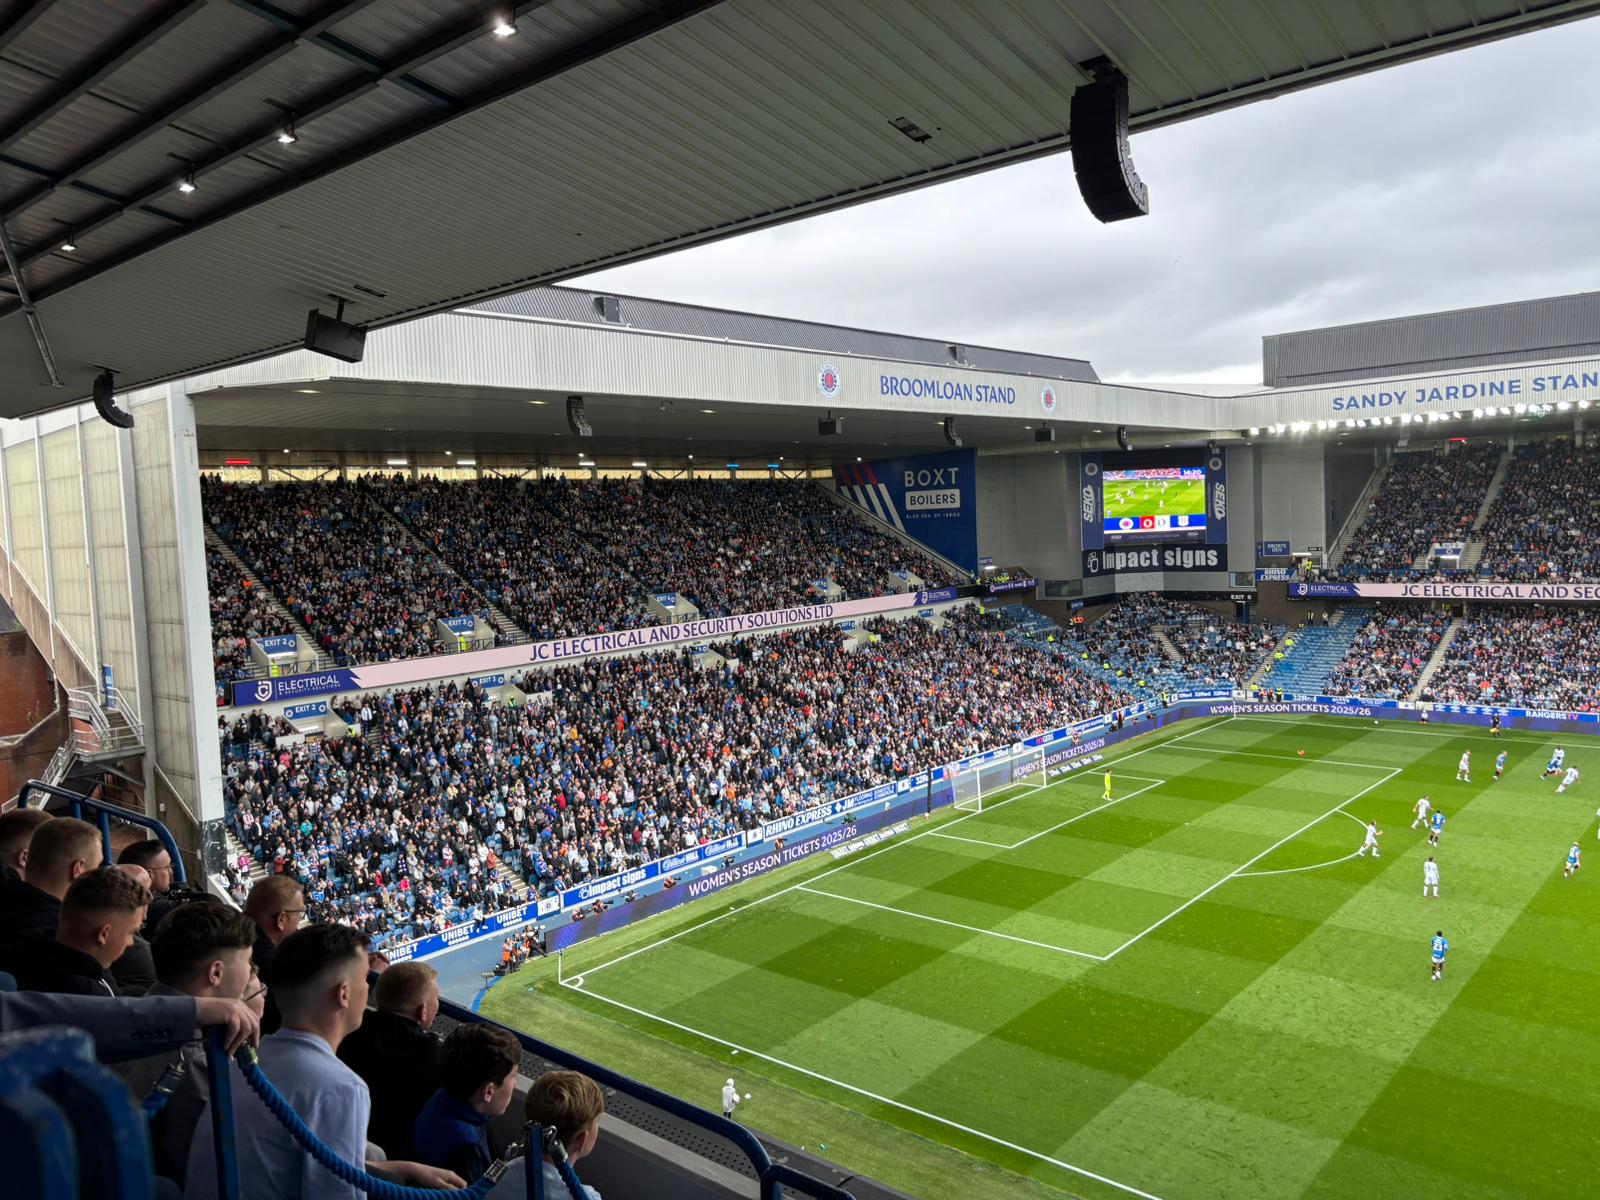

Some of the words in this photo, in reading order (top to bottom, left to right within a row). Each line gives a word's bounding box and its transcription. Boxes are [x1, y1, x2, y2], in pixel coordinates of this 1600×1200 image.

[880, 375, 973, 401] BROOMLOAN
[975, 384, 1016, 404] STAND
[1332, 390, 1407, 411] SANDY
[1415, 379, 1521, 404] JARDINE
[1531, 371, 1598, 392] STAN
[904, 467, 959, 487] BOXT
[910, 494, 956, 506] BOILERS
[1083, 485, 1096, 522] SEKO
[1213, 482, 1226, 519] SEKO
[1102, 549, 1159, 570] Impact
[1164, 547, 1218, 568] signs
[1311, 584, 1349, 592] ELECTRICAL
[1401, 585, 1420, 597] JC
[1423, 585, 1524, 598] ELECTRICAL
[1528, 586, 1569, 598] AND
[530, 643, 550, 661] JC
[553, 630, 646, 658] ELECTRICAL
[650, 625, 680, 644] AND
[683, 615, 745, 638] SECURITY
[747, 606, 812, 629] SOLUTIONS
[814, 604, 833, 619] LTD
[265, 639, 281, 647] EXIT
[278, 675, 340, 692] ELECTRICAL
[295, 704, 311, 713] EXIT
[311, 703, 316, 711] 2
[1210, 703, 1252, 714] WOMEN'S
[1253, 703, 1290, 713] SEASON
[1292, 703, 1329, 713] TICKETS
[1331, 705, 1371, 716] 2025/26
[1013, 761, 1040, 777] WOMEN'S
[1062, 744, 1084, 760] TICKETS
[1084, 737, 1105, 753] 2025/26
[841, 798, 855, 811] JM
[765, 820, 795, 837] RHINO
[795, 803, 833, 827] EXPRESS
[685, 850, 699, 863] HILL
[688, 867, 741, 897] WOMEN'S
[742, 851, 782, 877] SEASON
[782, 838, 820, 861] TICKETS
[821, 824, 857, 847] 2025/26
[589, 878, 622, 897] Impact
[621, 867, 647, 885] signs
[496, 906, 528, 924] UNIBET
[441, 924, 475, 942] UNIBET
